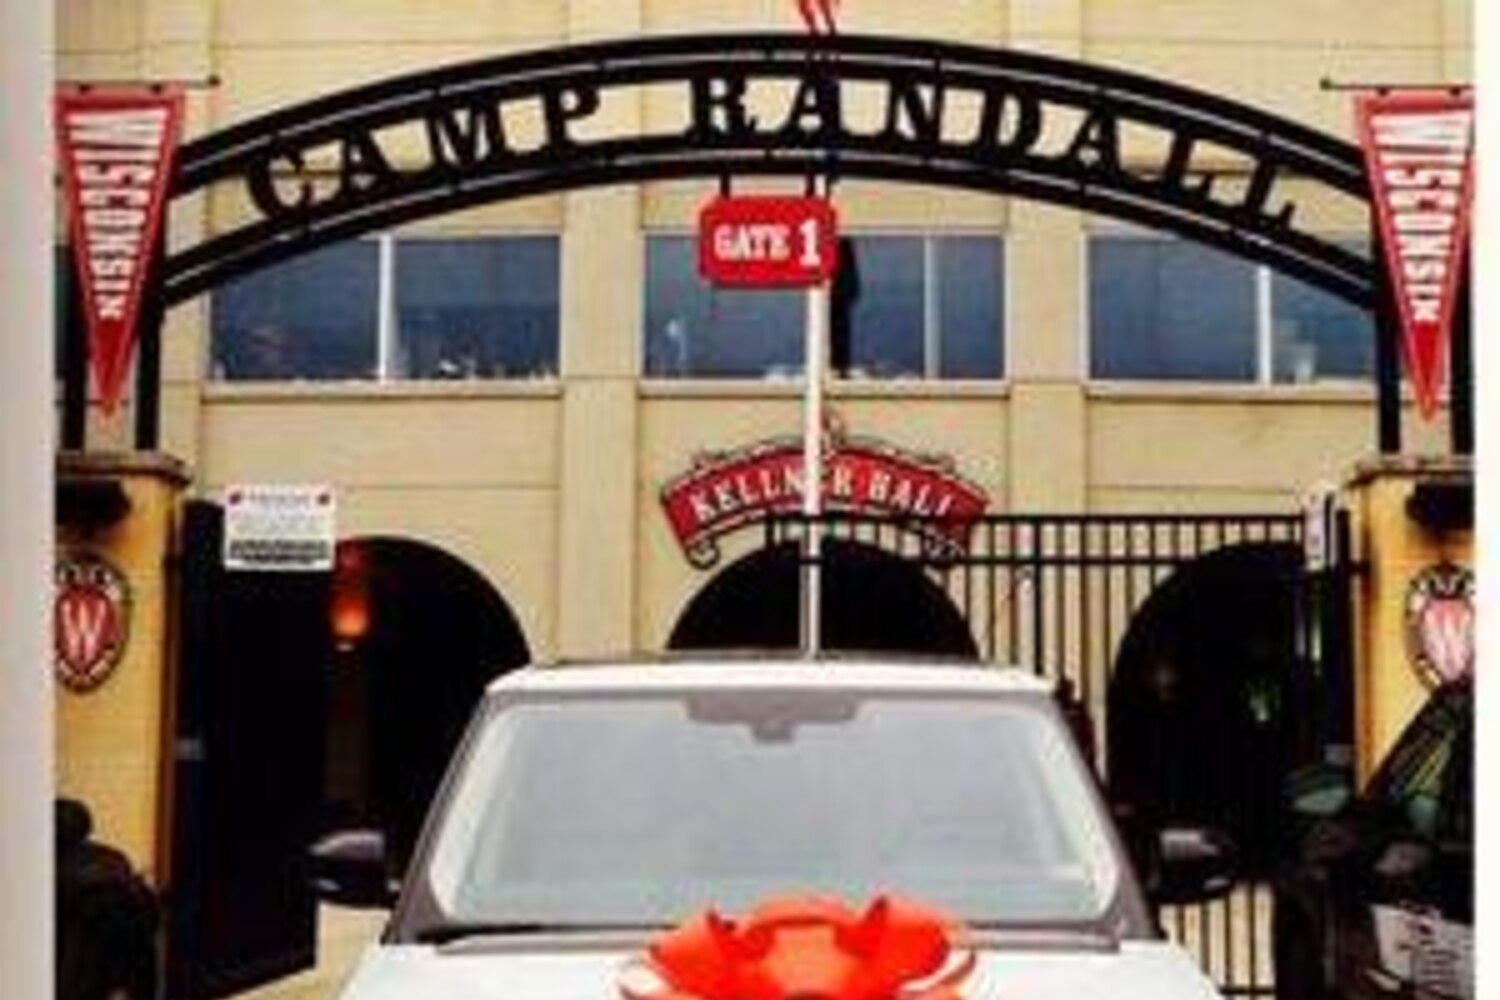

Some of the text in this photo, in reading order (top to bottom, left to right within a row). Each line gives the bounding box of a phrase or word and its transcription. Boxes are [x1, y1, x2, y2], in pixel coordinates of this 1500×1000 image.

[245, 74, 1297, 235] CAMP RANDALL
[66, 108, 168, 320] WISCONSIN
[713, 219, 821, 265] GATE 1
[1369, 111, 1473, 322] WISCONSIN
[689, 464, 853, 522] KELLNR
[61, 598, 107, 661] W
